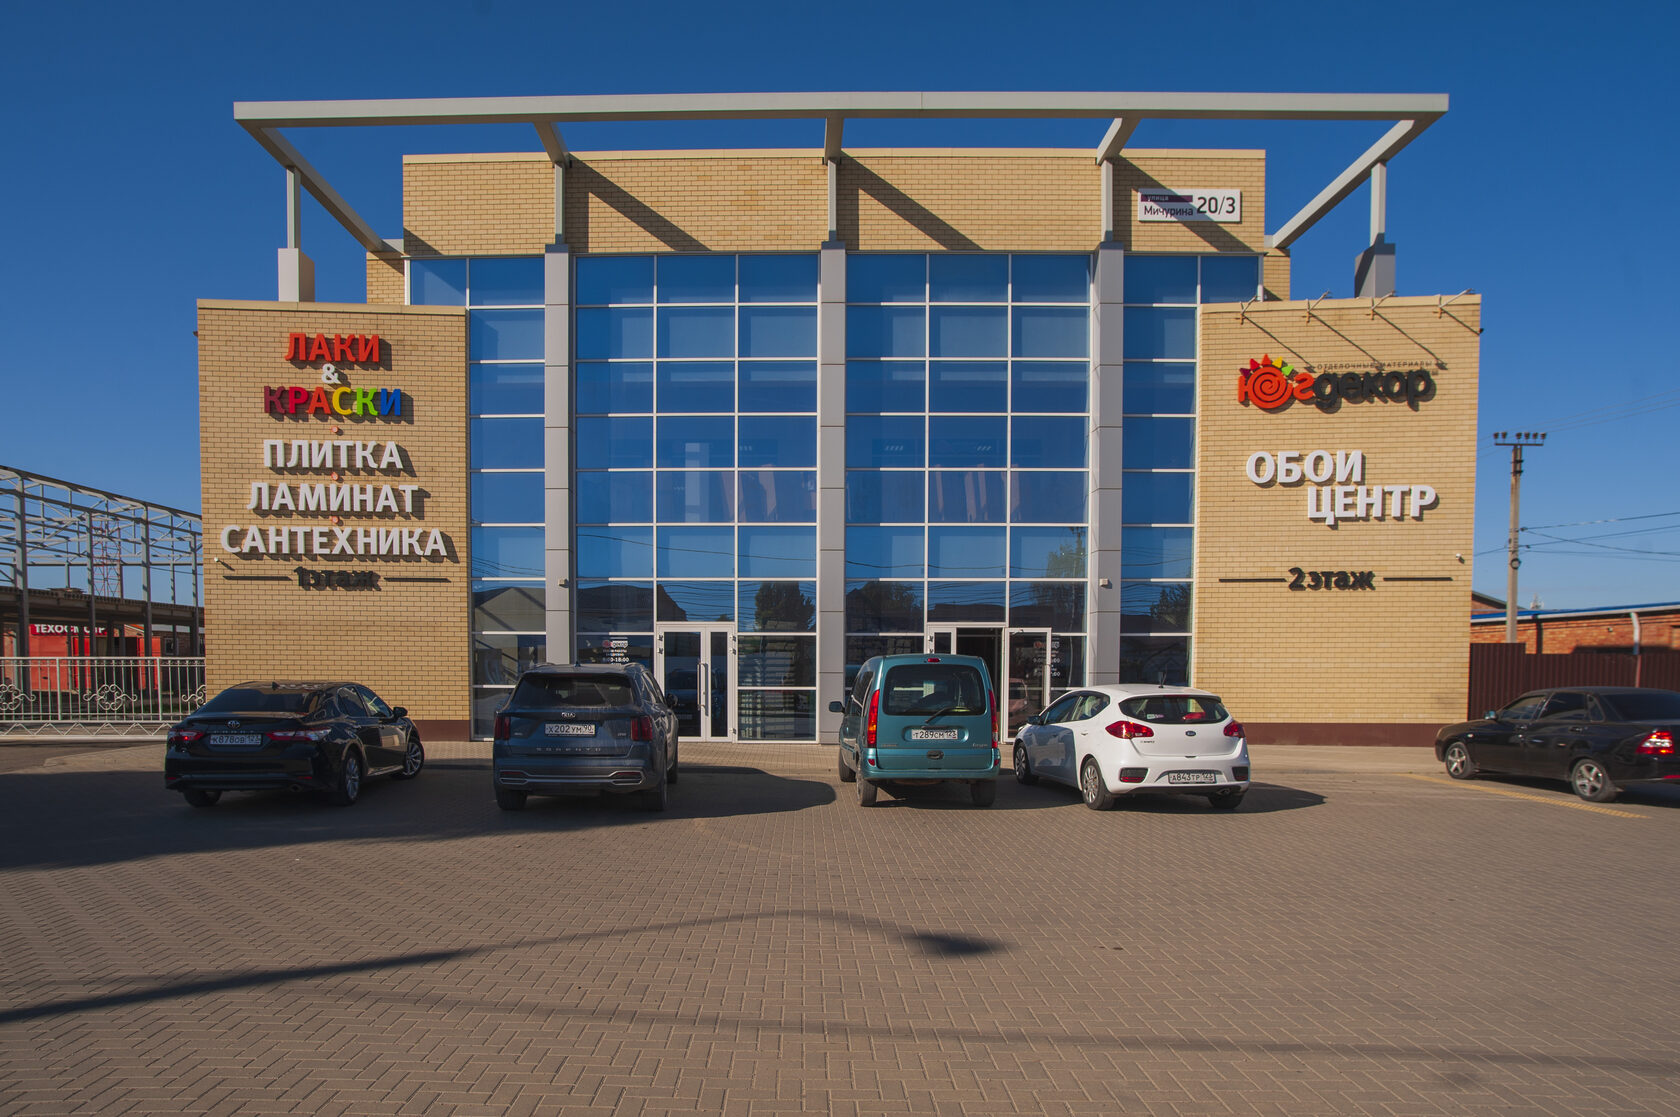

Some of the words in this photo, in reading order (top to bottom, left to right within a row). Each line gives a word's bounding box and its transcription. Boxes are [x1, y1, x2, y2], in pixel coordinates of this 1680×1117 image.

[1144, 205, 1193, 217] Мичурина
[1197, 196, 1236, 215] 20/3
[284, 332, 380, 362] ЛАКИ
[321, 363, 340, 384] &
[263, 385, 401, 417] КРАСКИ
[263, 439, 403, 469] ПЛИТКА
[1246, 449, 1363, 484] ОБОИ
[247, 482, 418, 513] ЛАМИНАТ
[1307, 485, 1437, 525] ЦЕНТР
[220, 524, 448, 556] САНТЕХНИКА
